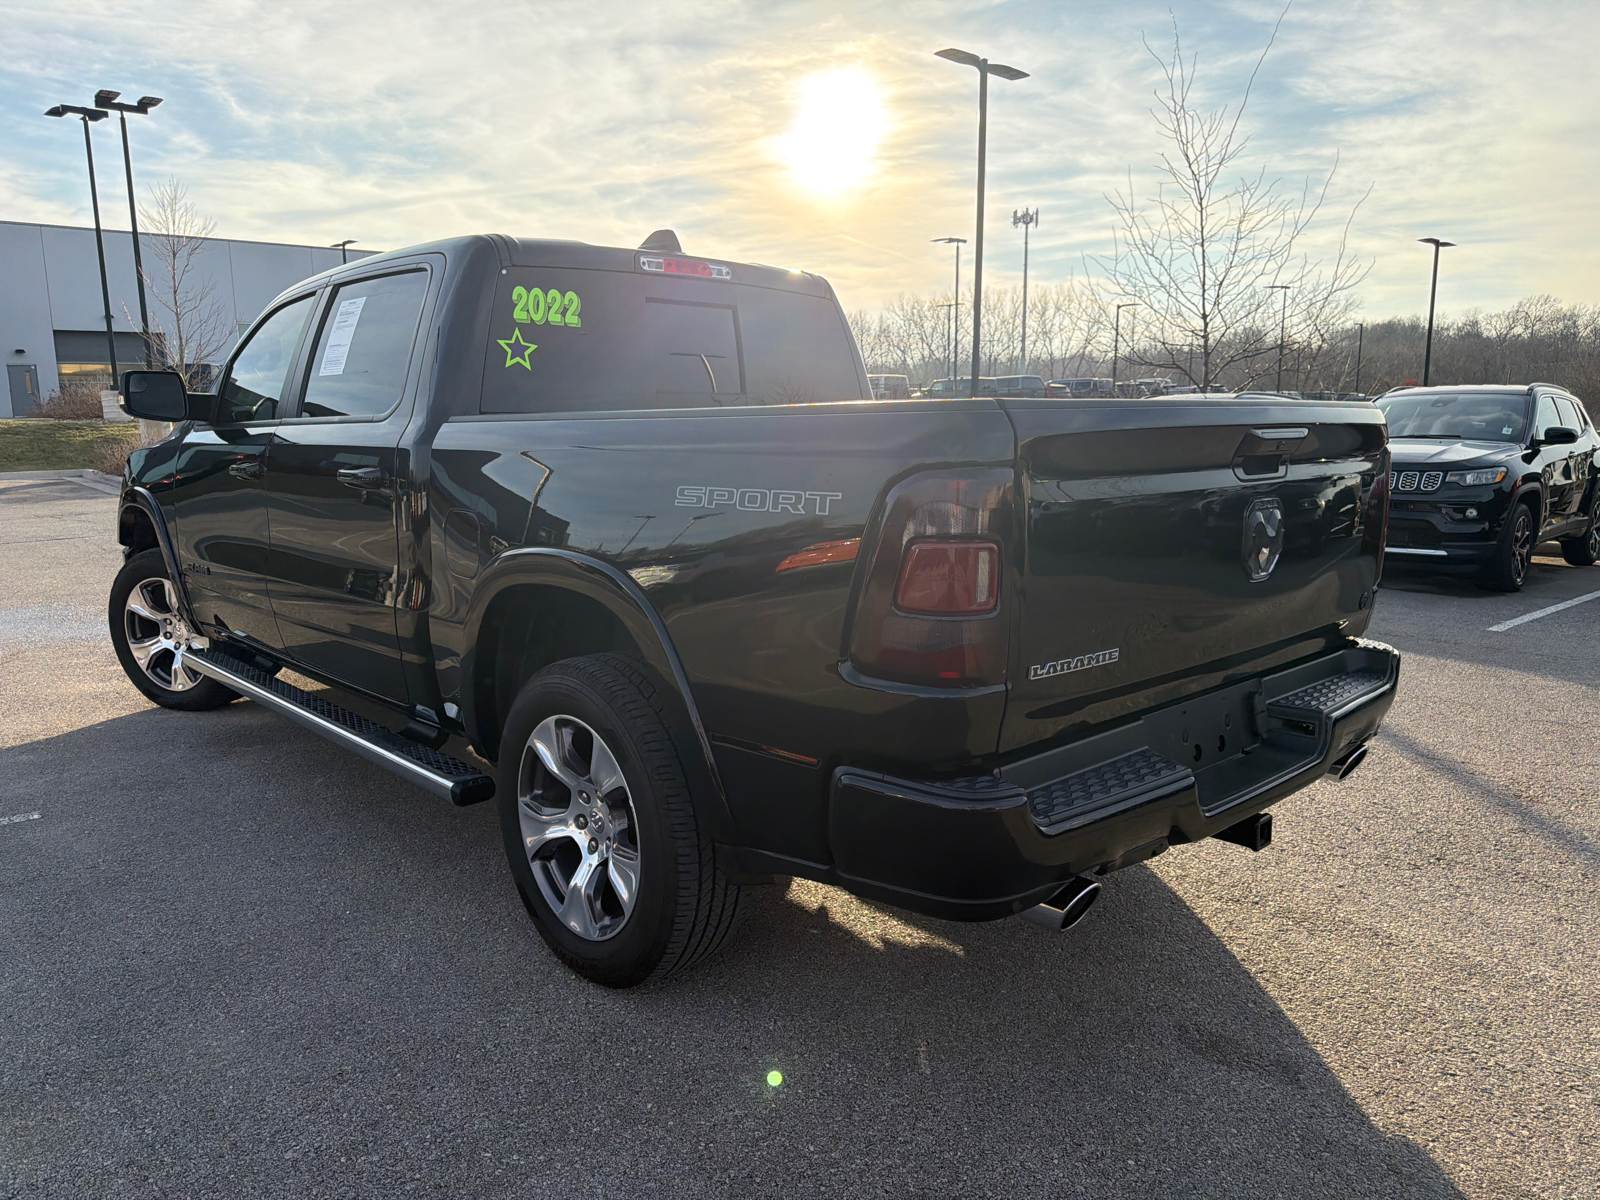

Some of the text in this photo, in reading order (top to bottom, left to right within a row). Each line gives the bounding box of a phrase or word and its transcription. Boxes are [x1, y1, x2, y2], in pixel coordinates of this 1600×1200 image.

[512, 285, 582, 328] 2022
[674, 485, 842, 516] SPORT
[1028, 647, 1119, 680] LARAMIE
